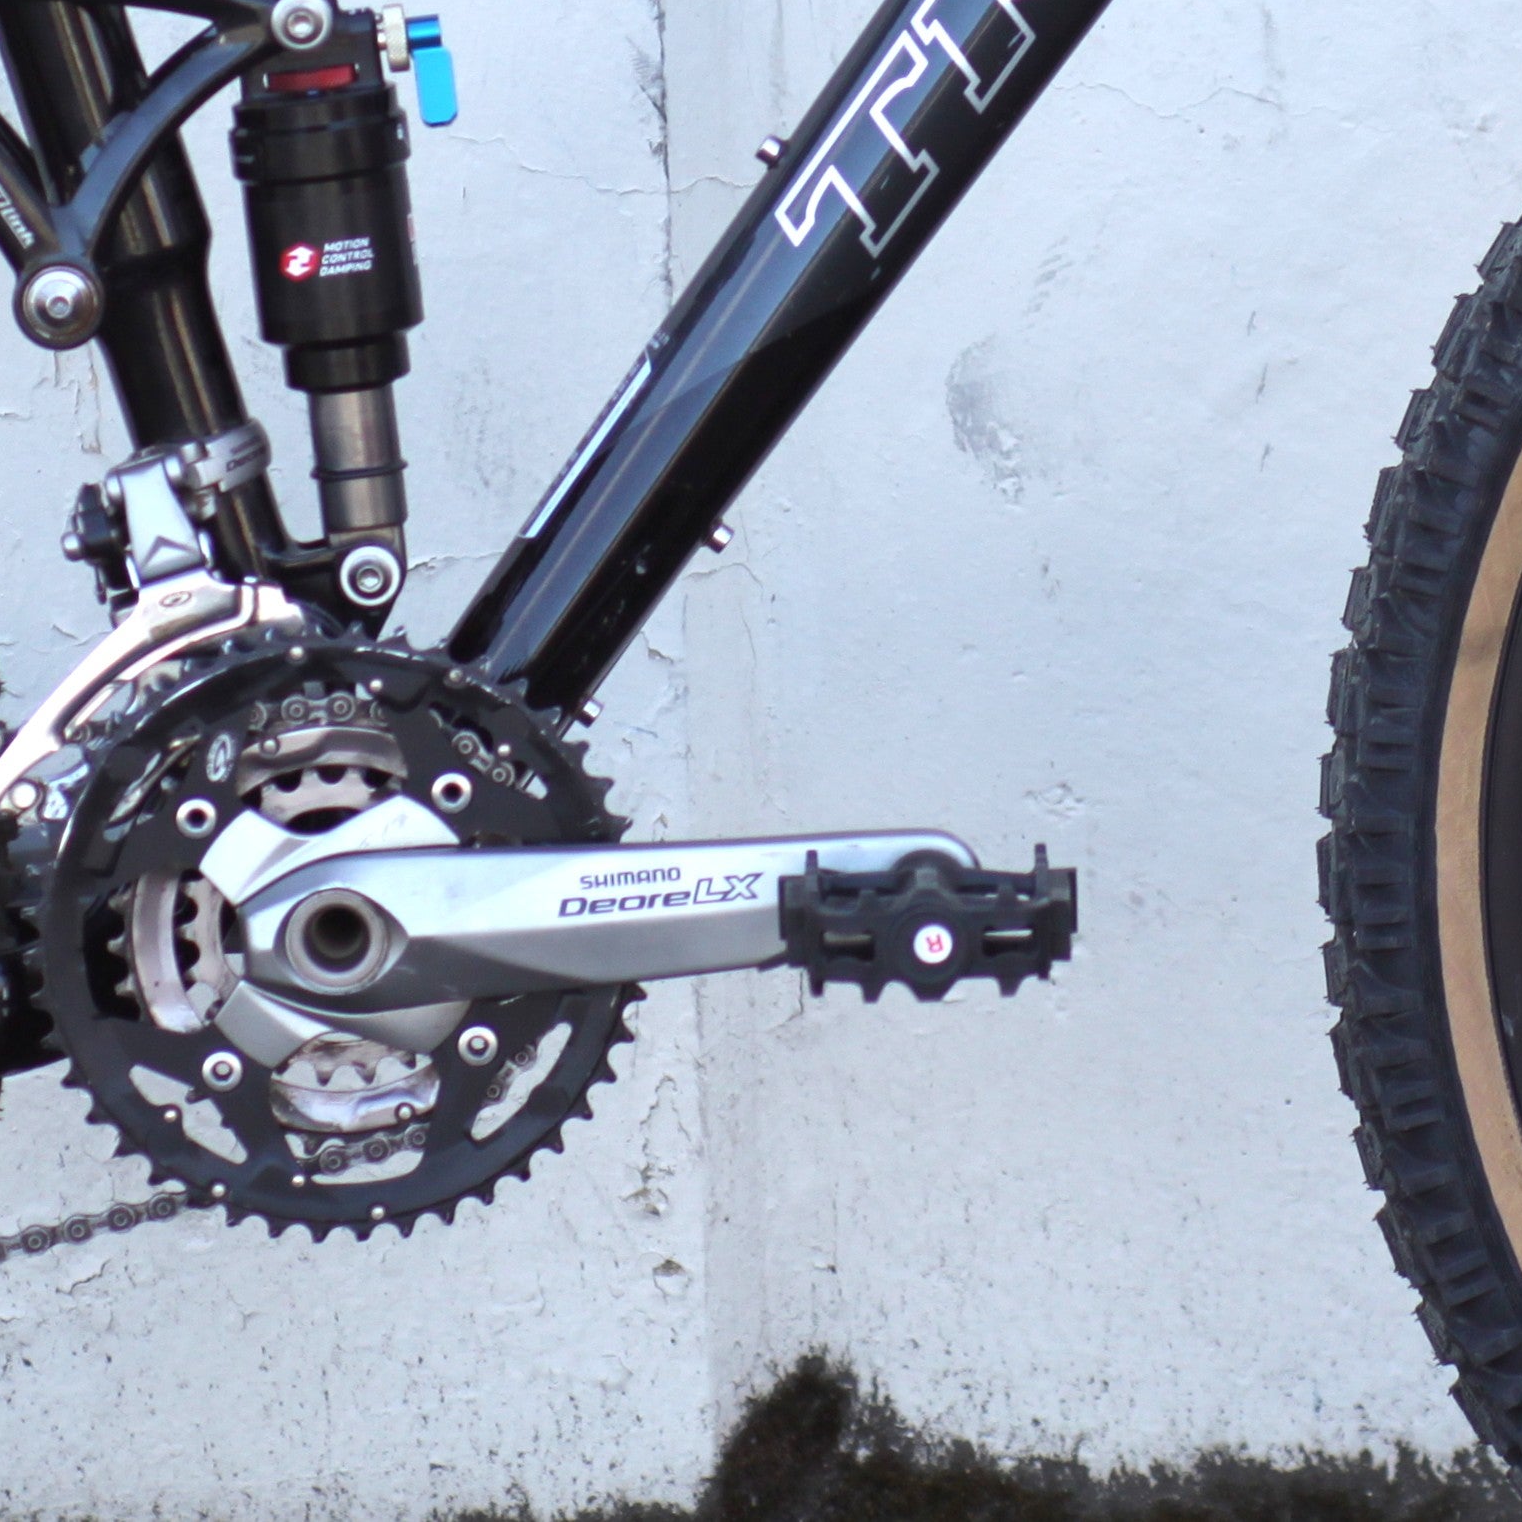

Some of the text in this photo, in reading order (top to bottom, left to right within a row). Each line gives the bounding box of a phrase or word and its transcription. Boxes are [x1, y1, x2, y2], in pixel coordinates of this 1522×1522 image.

[323, 237, 371, 253] MOTION
[321, 248, 375, 265] CONTROL
[319, 260, 372, 277] DAMPING
[579, 867, 681, 891] SHIMANO
[557, 872, 764, 919] Deore LX
